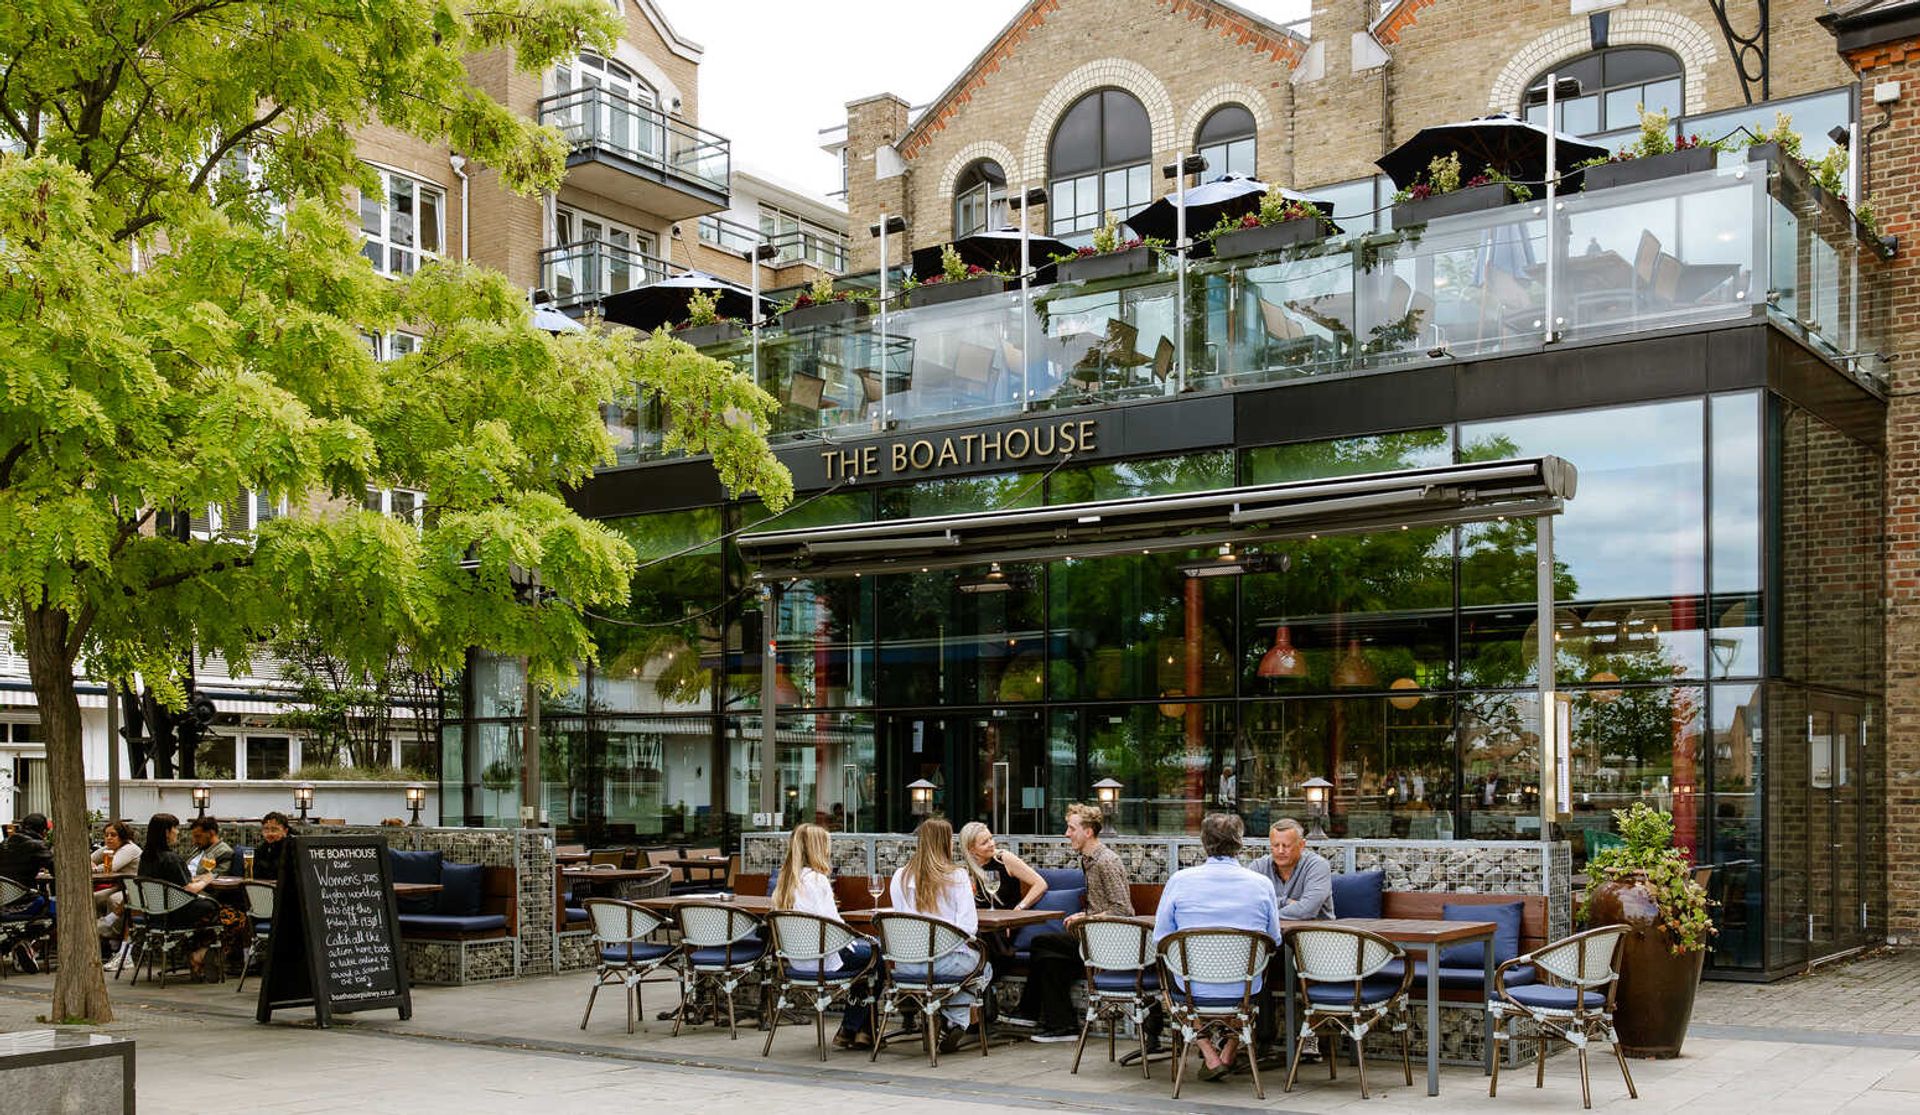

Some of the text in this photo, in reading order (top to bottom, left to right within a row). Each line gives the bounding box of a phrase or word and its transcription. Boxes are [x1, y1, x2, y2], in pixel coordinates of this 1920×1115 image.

[821, 420, 1096, 479] THE BOATHOUSE
[309, 848, 377, 859] THE BOATHOUSE
